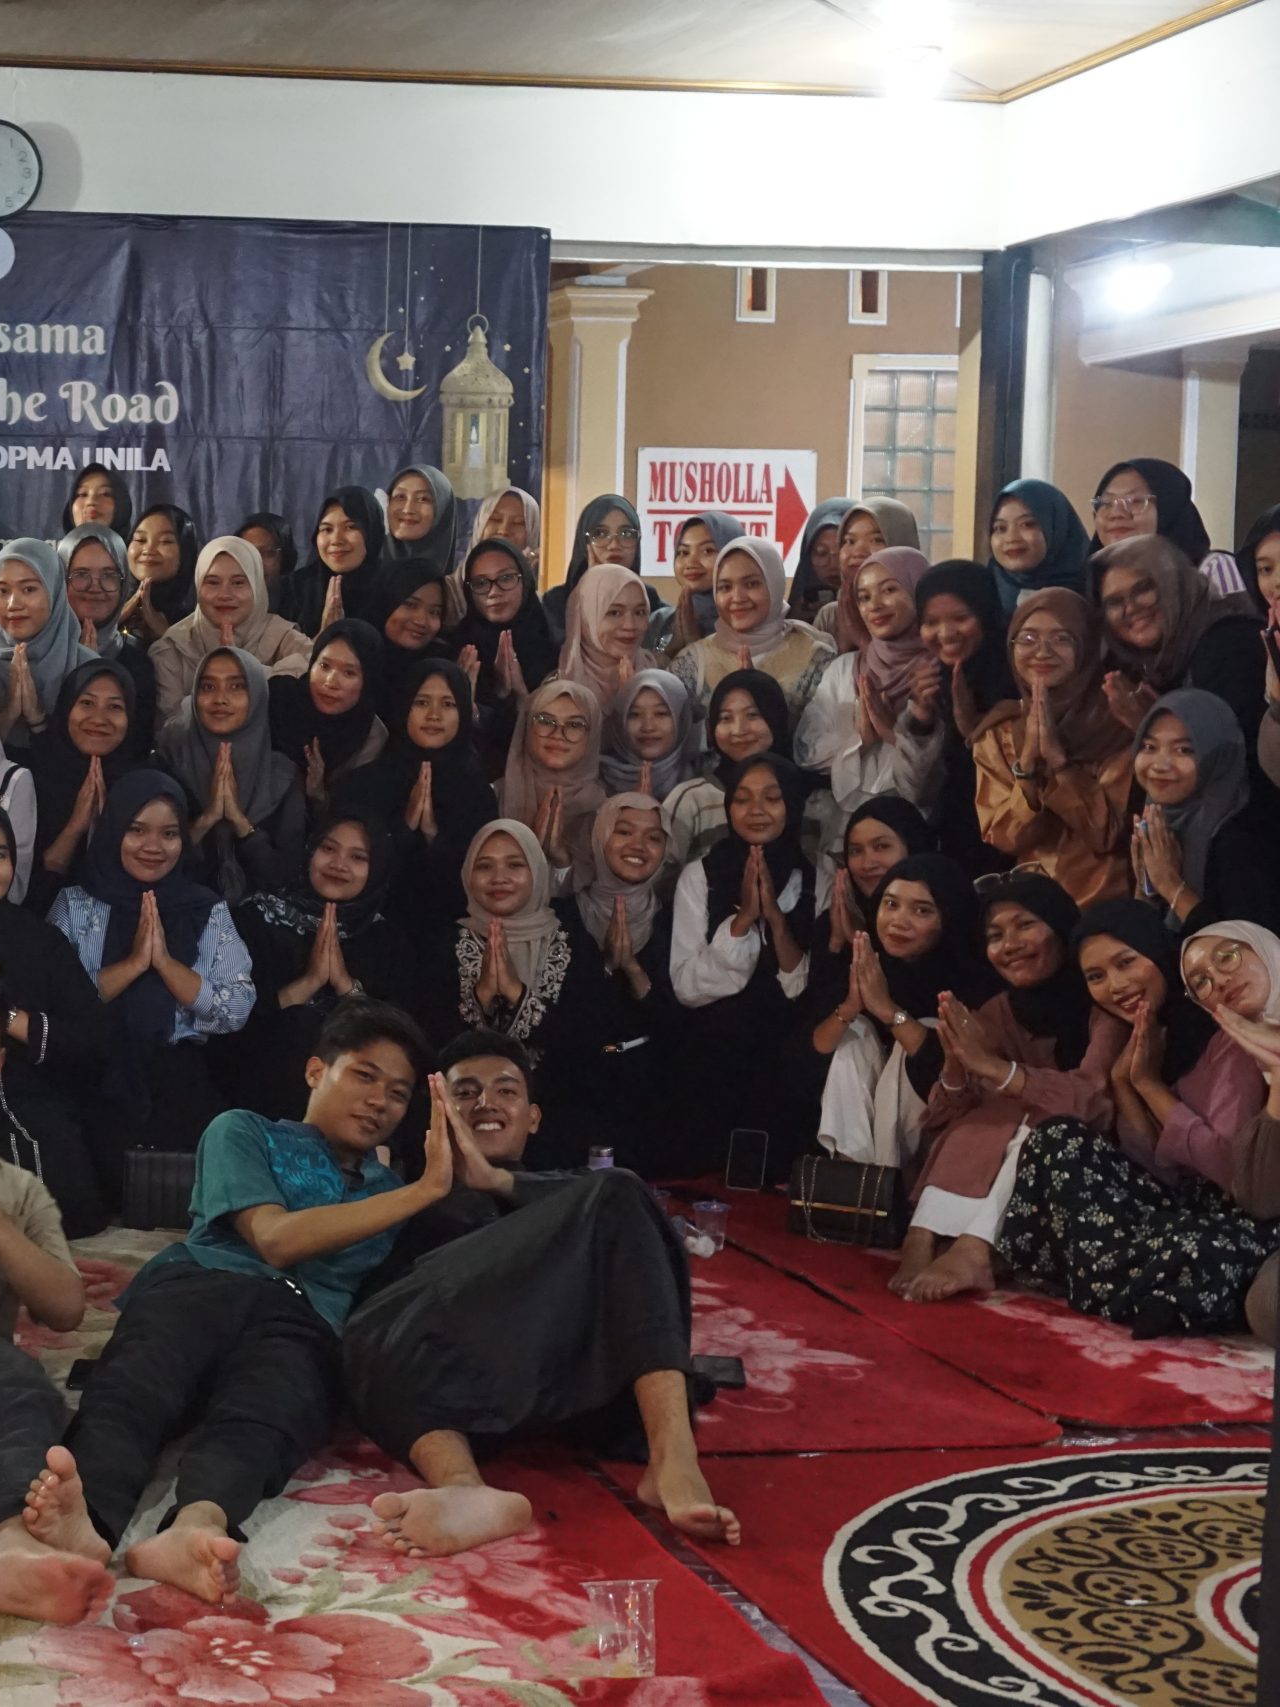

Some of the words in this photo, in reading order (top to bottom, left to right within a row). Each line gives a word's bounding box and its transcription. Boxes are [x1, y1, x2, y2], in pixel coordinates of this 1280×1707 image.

[59, 380, 180, 431] Road
[83, 447, 171, 471] UNILA
[648, 461, 773, 503] MUSHOLLA
